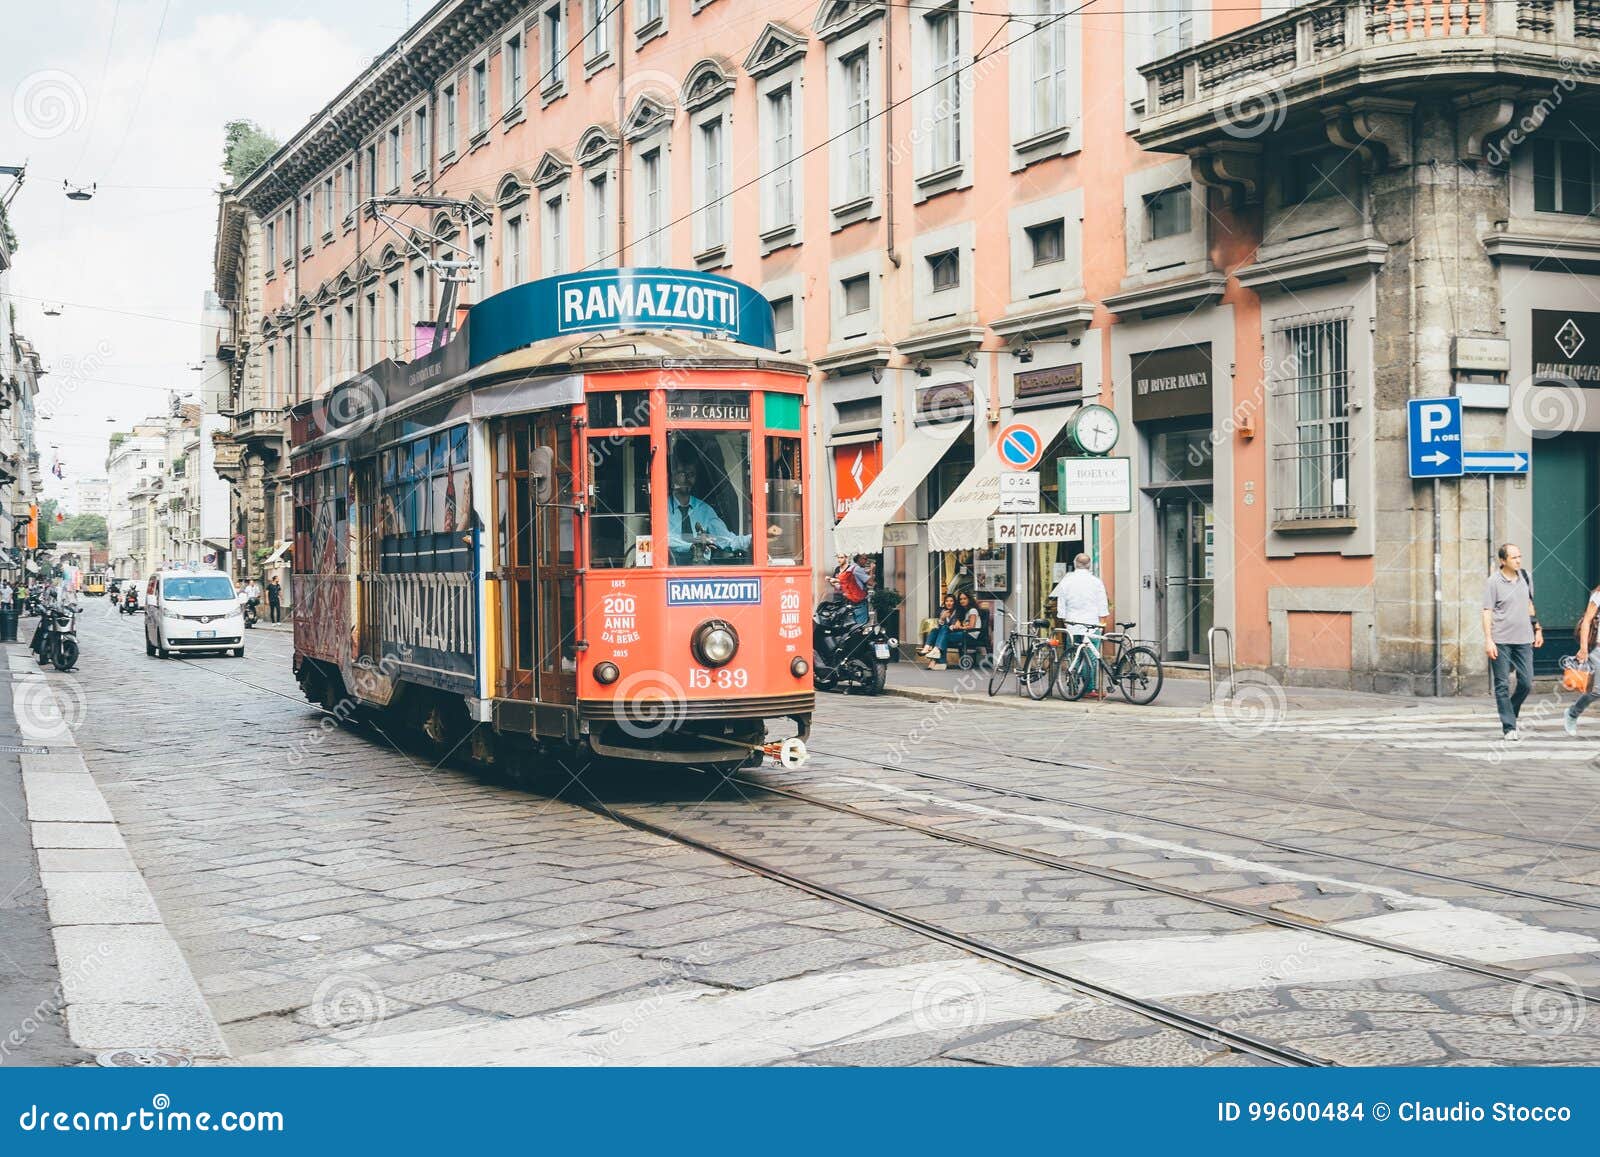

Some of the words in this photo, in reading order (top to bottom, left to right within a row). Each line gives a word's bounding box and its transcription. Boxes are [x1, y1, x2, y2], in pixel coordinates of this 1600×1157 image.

[564, 283, 735, 326] RAMAZZOTTI
[1178, 371, 1208, 389] BANCA
[690, 405, 699, 419] P.
[1420, 404, 1452, 443] P
[1442, 433, 1461, 441] ORE
[1000, 522, 1077, 538] PATICCERIA
[638, 541, 650, 552] 41
[611, 579, 626, 588] 1815
[671, 583, 757, 600] RAMAZZOTTI
[604, 598, 635, 613] 200
[781, 594, 799, 609] 200
[604, 617, 635, 629] ANNI
[781, 613, 799, 625] ANNI
[601, 632, 615, 643] DA
[616, 631, 640, 644] BERE
